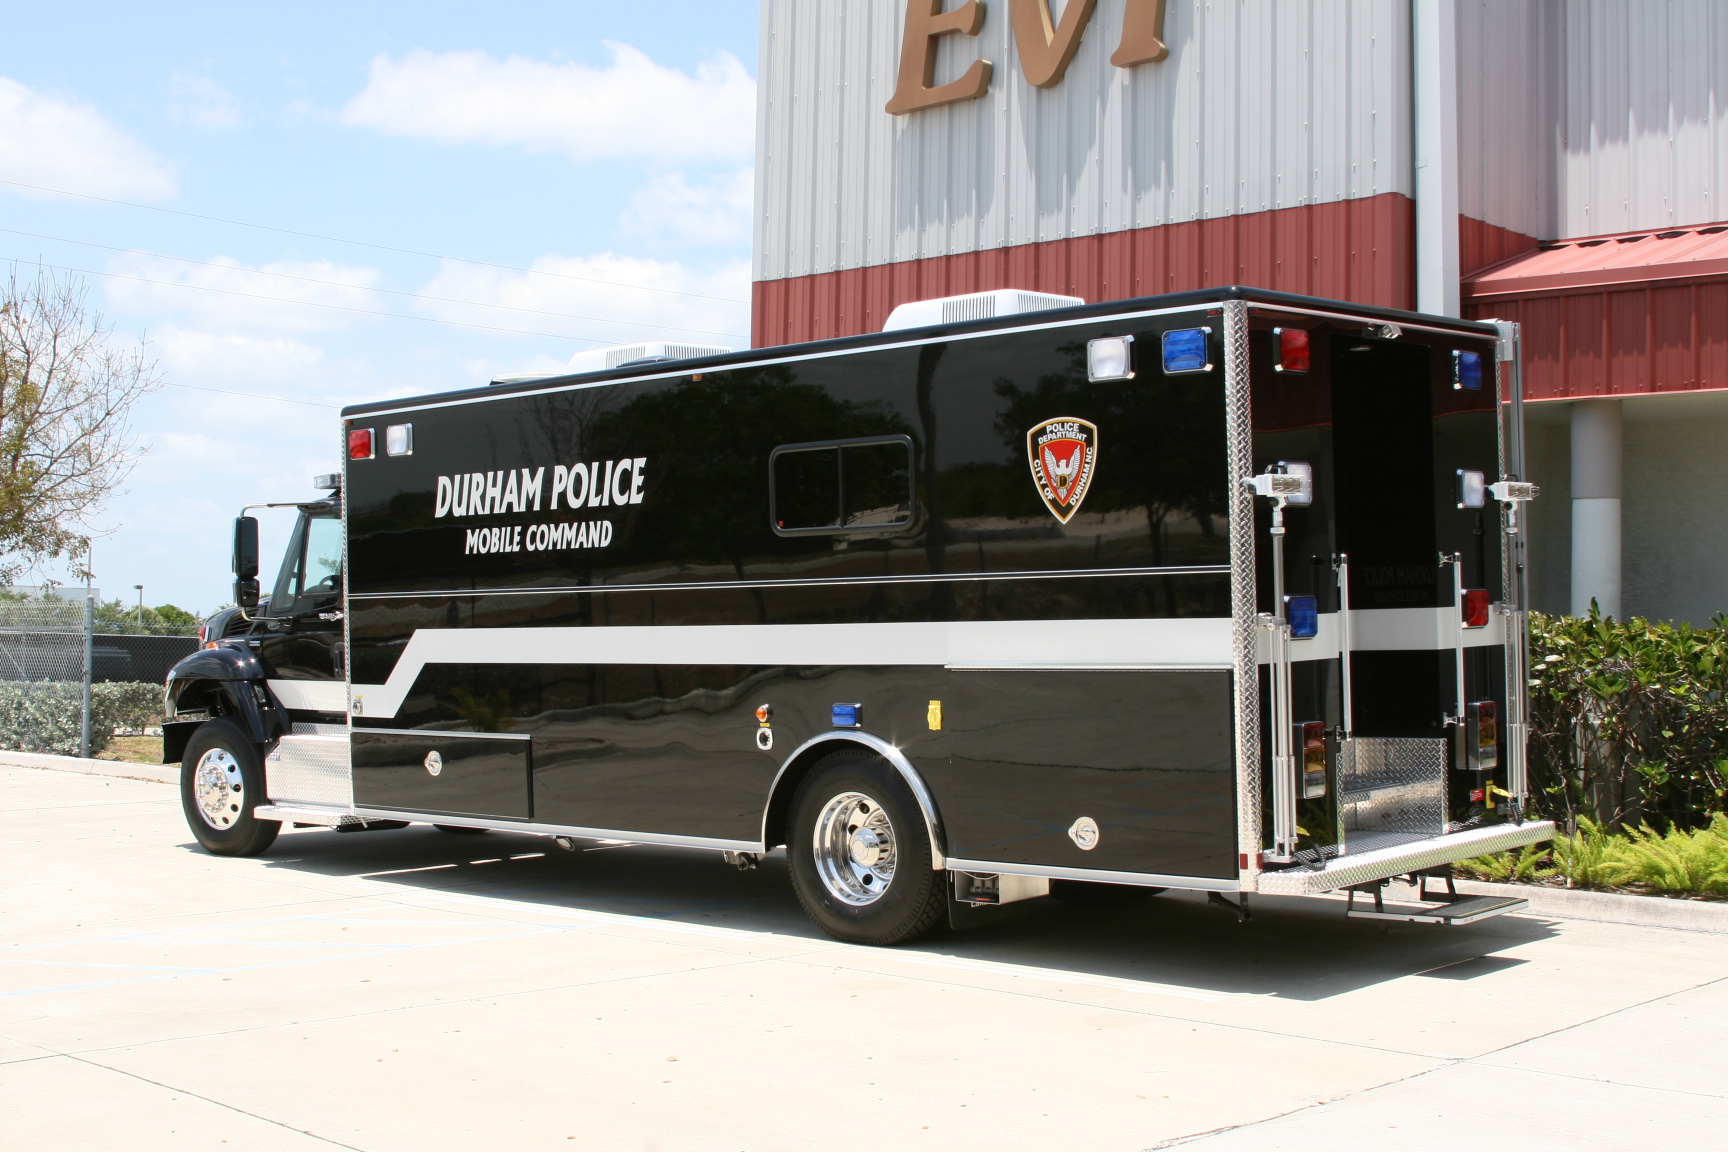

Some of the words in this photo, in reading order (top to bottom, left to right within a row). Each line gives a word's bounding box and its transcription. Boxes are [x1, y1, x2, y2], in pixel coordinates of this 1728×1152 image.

[1038, 431, 1087, 444] DEPARTMENT
[1046, 423, 1079, 433] POLICE
[435, 467, 545, 518] DURHAM
[550, 457, 647, 510] POLICE
[1034, 459, 1046, 485] CITY
[1044, 488, 1054, 500] OF
[465, 526, 522, 555] MOBILE
[526, 520, 613, 552] COMMAND
